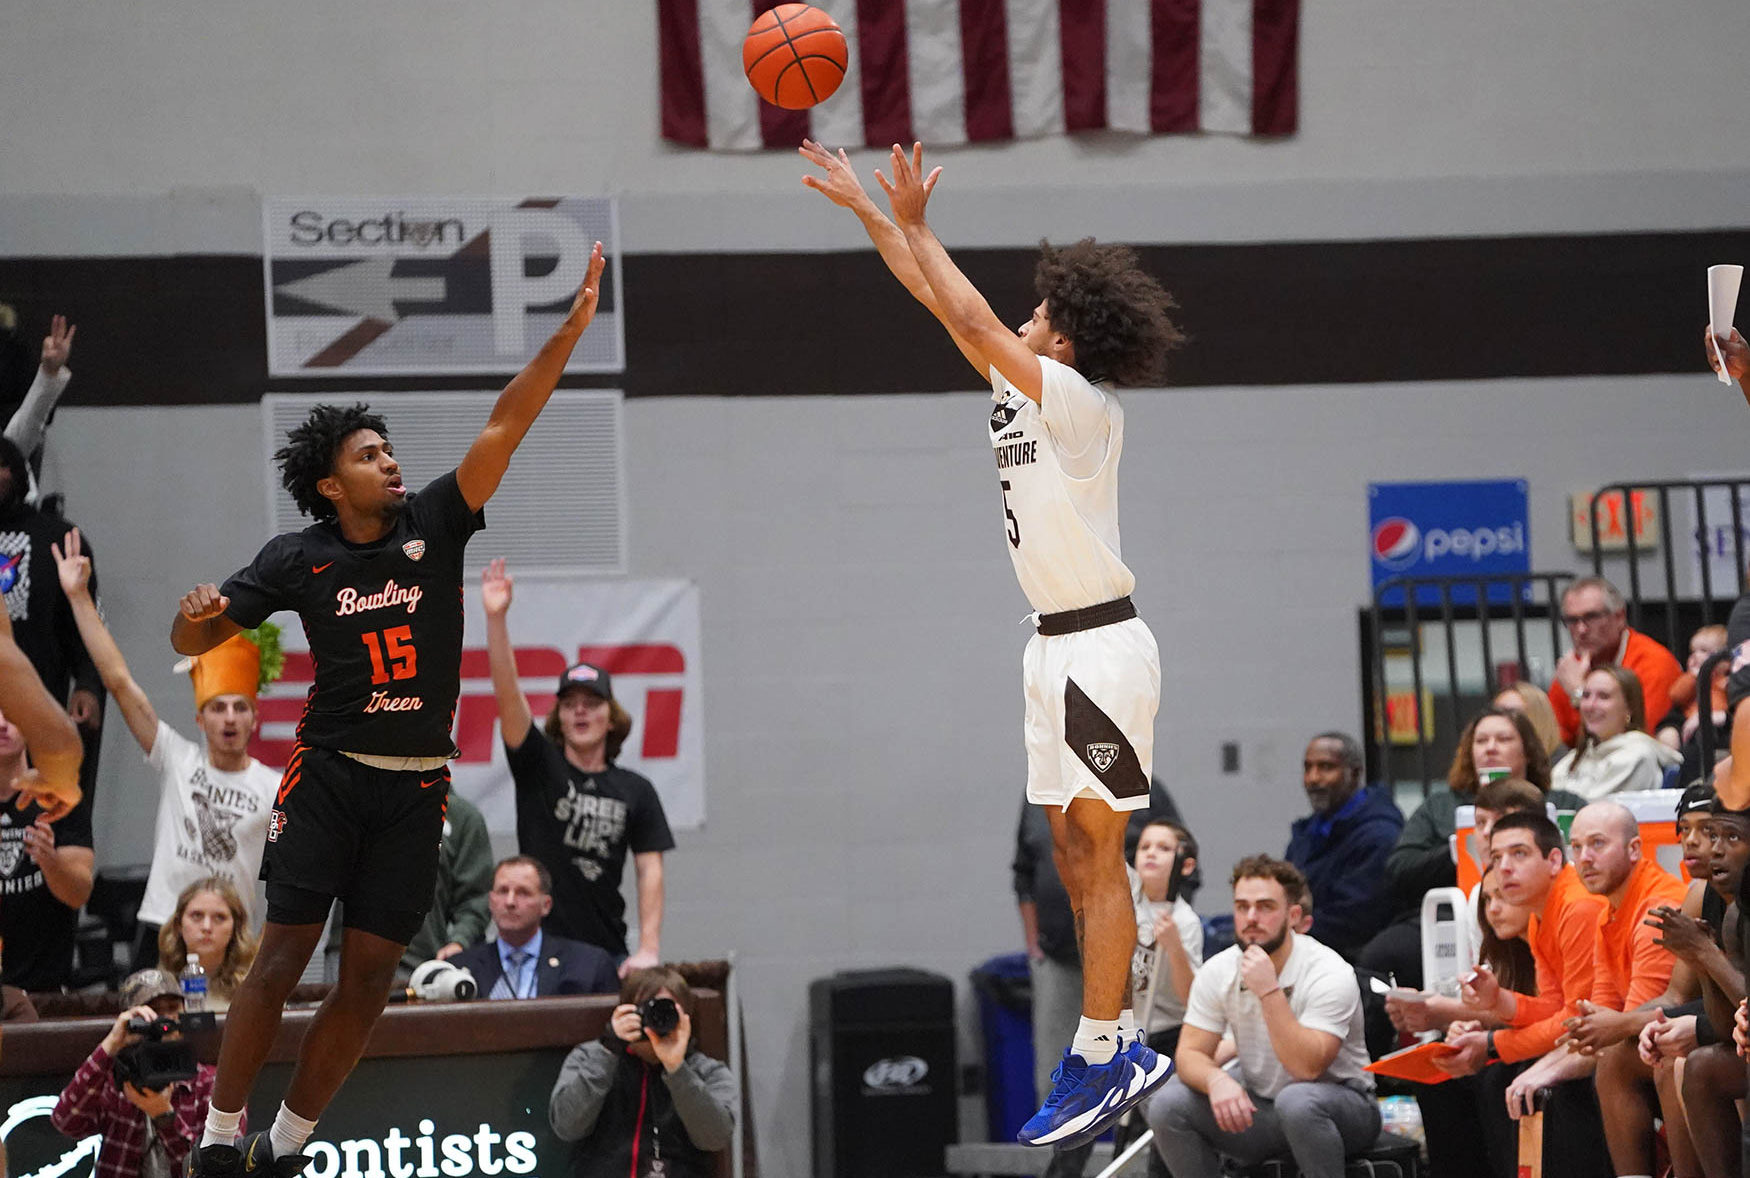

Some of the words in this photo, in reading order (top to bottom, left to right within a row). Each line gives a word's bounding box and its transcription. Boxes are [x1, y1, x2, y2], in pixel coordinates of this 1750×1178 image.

[1000, 480, 1021, 549] 5
[1425, 520, 1523, 564] pepsi
[336, 579, 423, 616] Bowling
[361, 624, 418, 685] 15
[247, 643, 686, 767] EPN
[363, 690, 424, 714] Green
